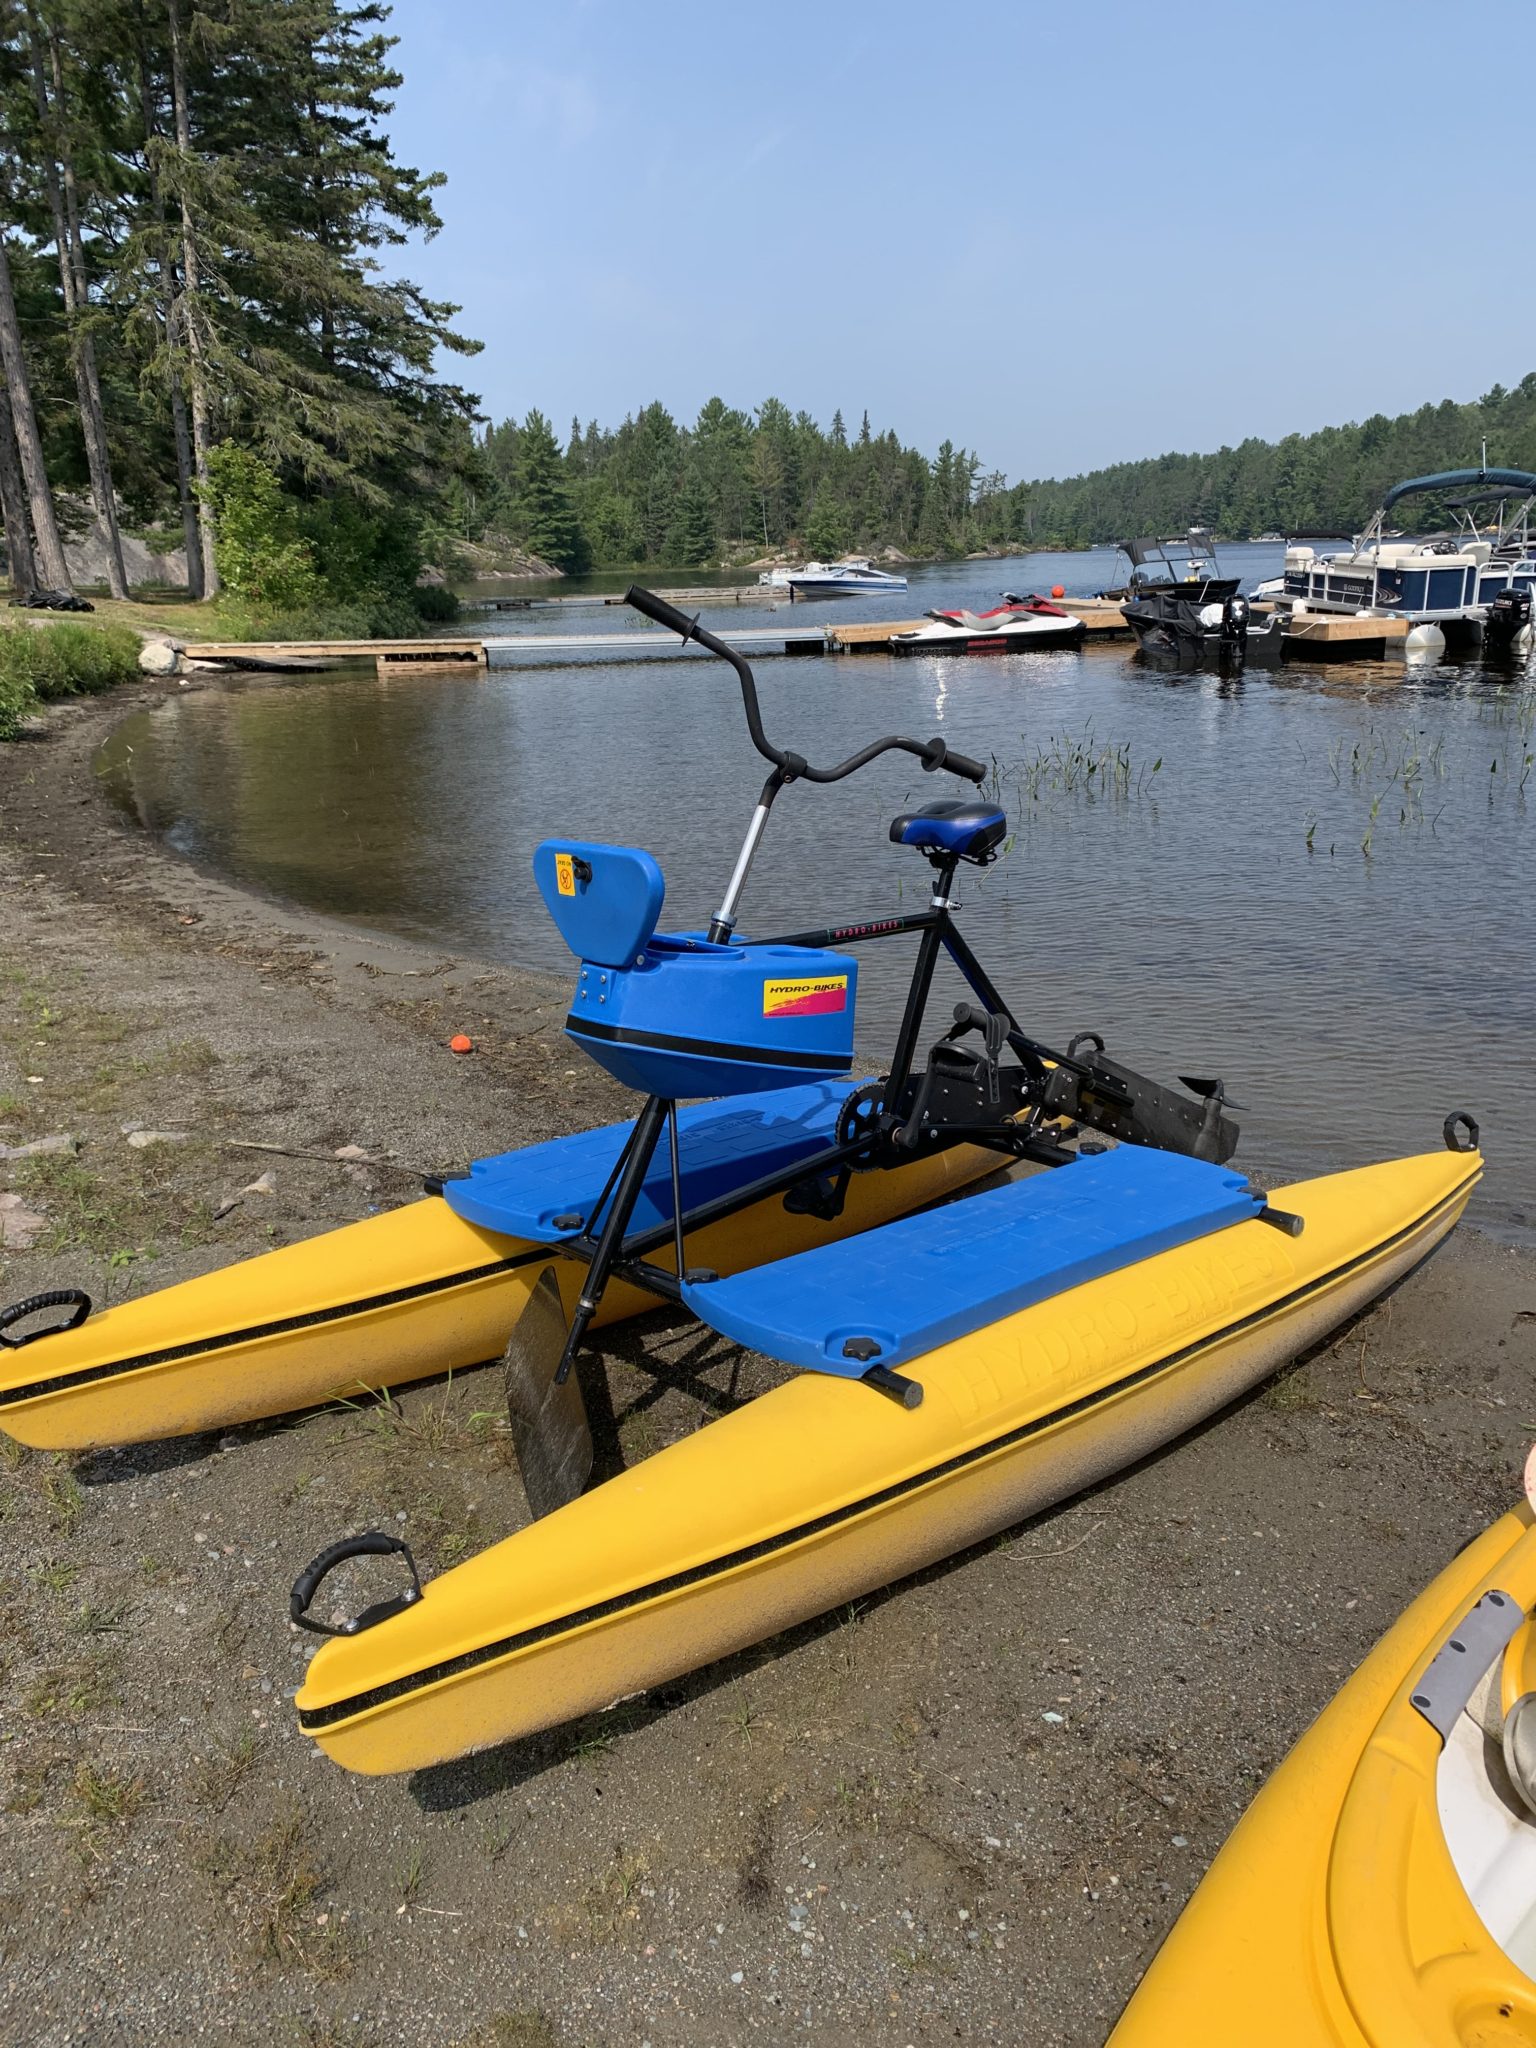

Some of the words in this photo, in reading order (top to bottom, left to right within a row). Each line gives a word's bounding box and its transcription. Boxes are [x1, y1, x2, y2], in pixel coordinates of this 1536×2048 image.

[835, 920, 898, 938] HYDRO-BIKES
[769, 982, 844, 994] HYDRO-BIKES
[955, 1243, 1274, 1415] HYDRO-BIKES
